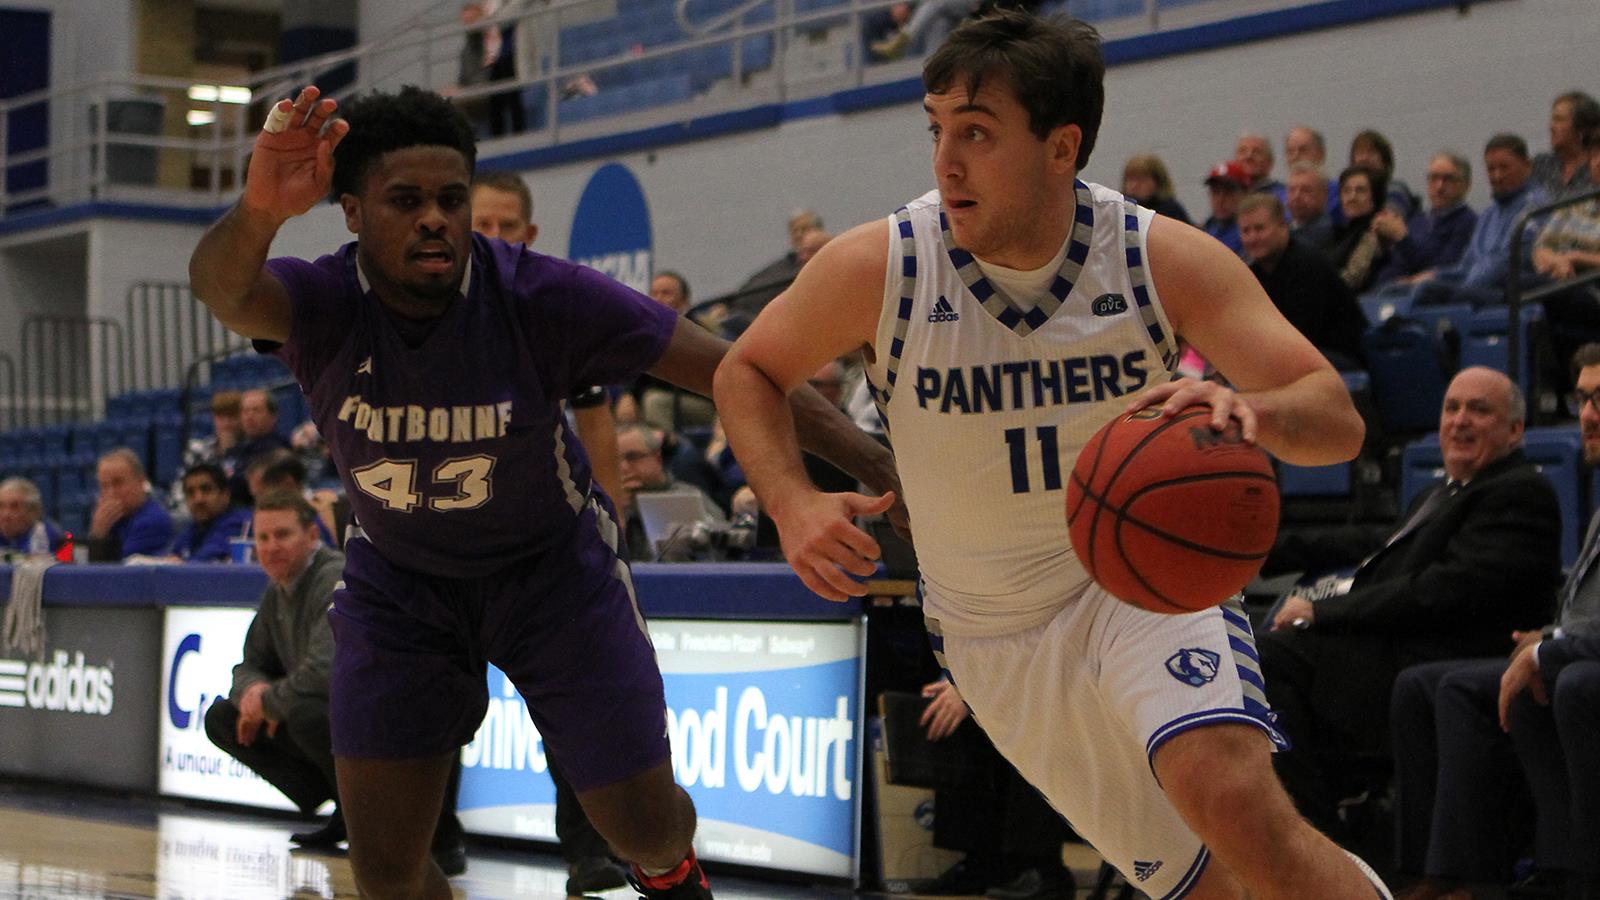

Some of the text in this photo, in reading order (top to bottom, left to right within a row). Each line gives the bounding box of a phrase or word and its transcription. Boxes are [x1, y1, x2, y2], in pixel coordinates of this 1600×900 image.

[915, 349, 1148, 414] PANTHERS
[350, 453, 497, 513] 43
[1004, 425, 1062, 494] 11
[27, 649, 114, 715] adidas
[177, 751, 222, 776] unique
[733, 686, 853, 801] Court
